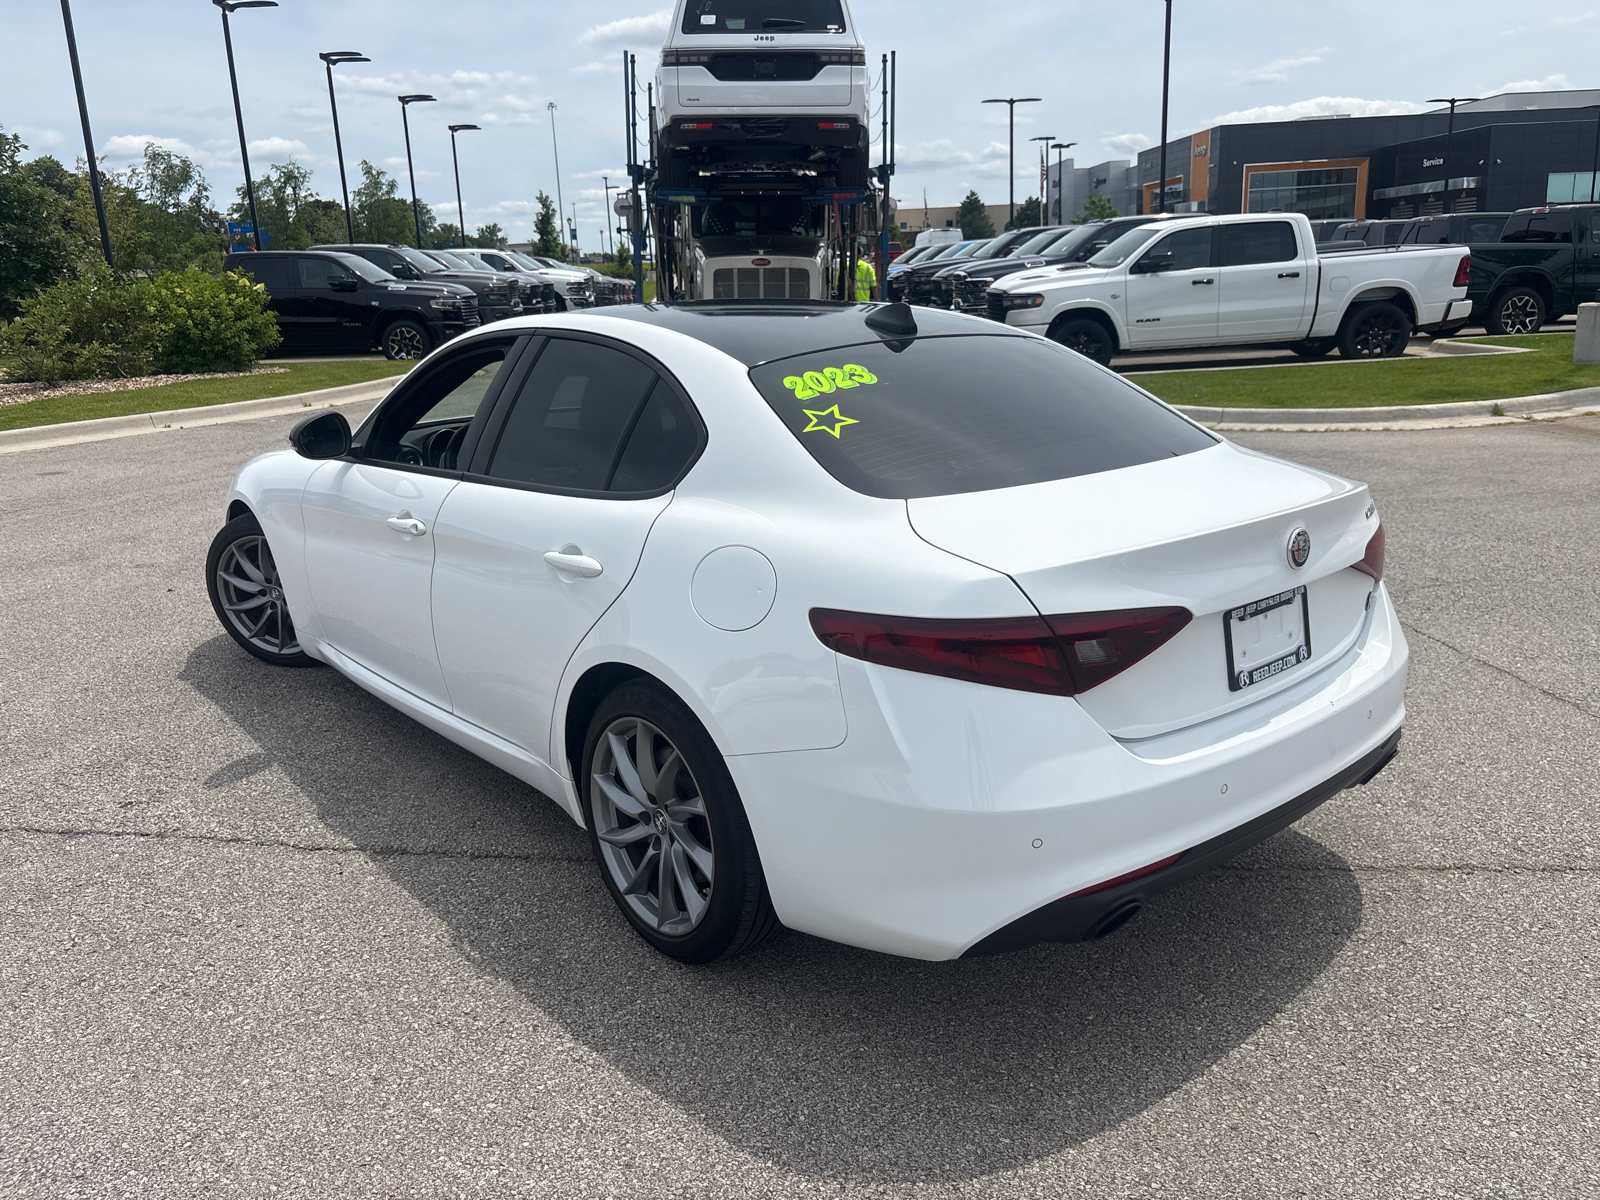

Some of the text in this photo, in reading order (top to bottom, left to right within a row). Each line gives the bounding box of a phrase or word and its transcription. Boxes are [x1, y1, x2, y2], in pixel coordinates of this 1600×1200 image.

[1193, 144, 1207, 157] Jeep
[1422, 157, 1444, 168] Service
[783, 363, 878, 401] 2023
[1231, 607, 1245, 619] REED
[1245, 603, 1257, 615] JEEP
[1257, 595, 1280, 610] CHRYSLER
[1252, 654, 1297, 683] REEDJEEP.COM
